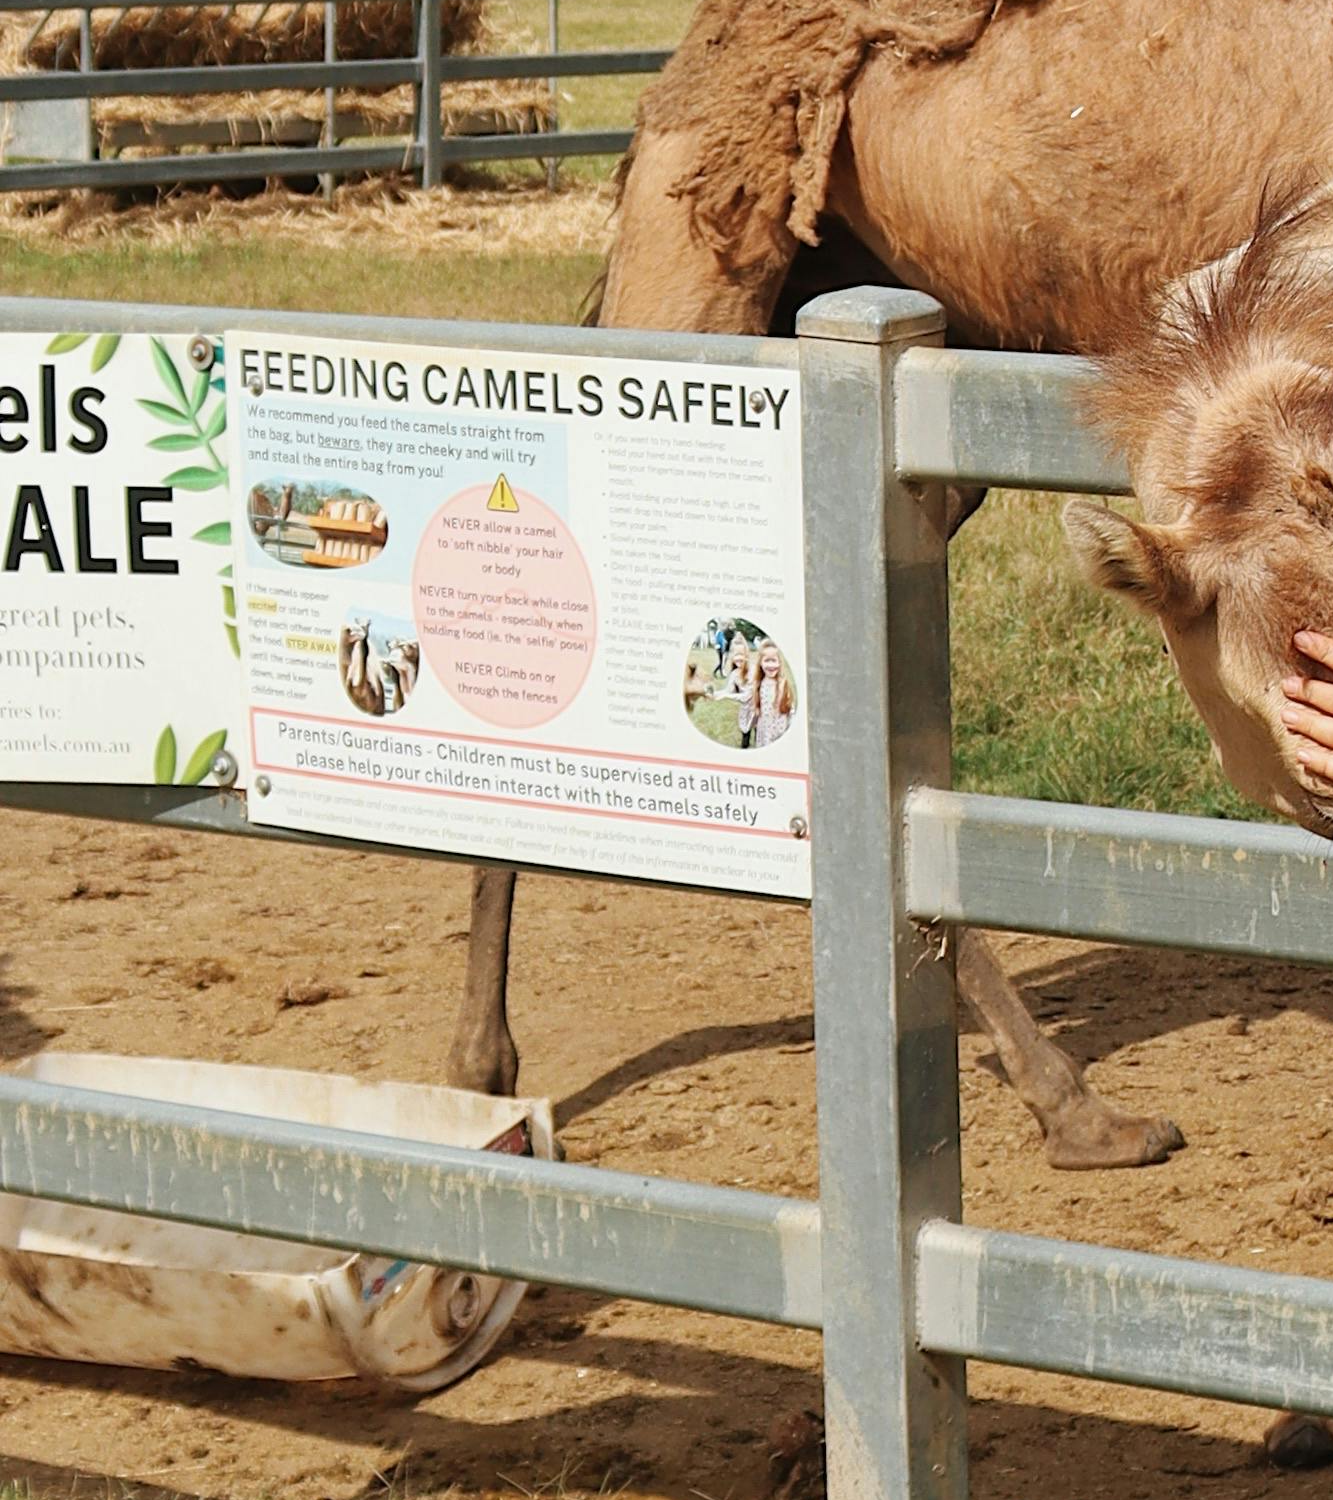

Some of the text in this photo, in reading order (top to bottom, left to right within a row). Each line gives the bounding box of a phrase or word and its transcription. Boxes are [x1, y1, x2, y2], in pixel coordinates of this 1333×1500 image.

[241, 349, 789, 429] FEEDING CAMELS SAFELY
[0, 364, 108, 454] els
[246, 403, 544, 442] We recommend you feed the camels straight from
[247, 425, 536, 466] the bag, but beware, they are cheeky and will try
[247, 447, 443, 479] and steal the entire bag from you!
[1, 485, 180, 575] ALE
[442, 516, 556, 538] NEVER allow a camel
[437, 537, 448, 548] to
[515, 546, 540, 558] your
[541, 546, 563, 559] hair
[481, 562, 521, 578] or body
[419, 584, 589, 612] NEVER turn your back while close
[425, 605, 436, 616] to
[437, 605, 455, 618] the
[456, 610, 493, 622] camels
[501, 615, 553, 630] especially
[555, 618, 583, 631] when
[285, 637, 309, 650] STEP
[309, 640, 337, 654] AWAY
[422, 623, 460, 640] holding
[462, 627, 485, 640] food
[504, 632, 521, 644] the
[559, 640, 588, 652] pose)
[0, 641, 145, 678] mpanions
[454, 661, 555, 684] NEVER Climb on or
[457, 681, 558, 704] through the fences
[278, 721, 422, 757] Parents/Guardians
[436, 742, 505, 767] Children
[510, 756, 551, 773] must
[555, 756, 576, 776] be
[580, 764, 673, 787] supervised
[677, 774, 695, 790] at
[700, 774, 722, 794] all
[726, 778, 776, 799] times
[295, 749, 758, 826] please help your children interact with the camels safely
